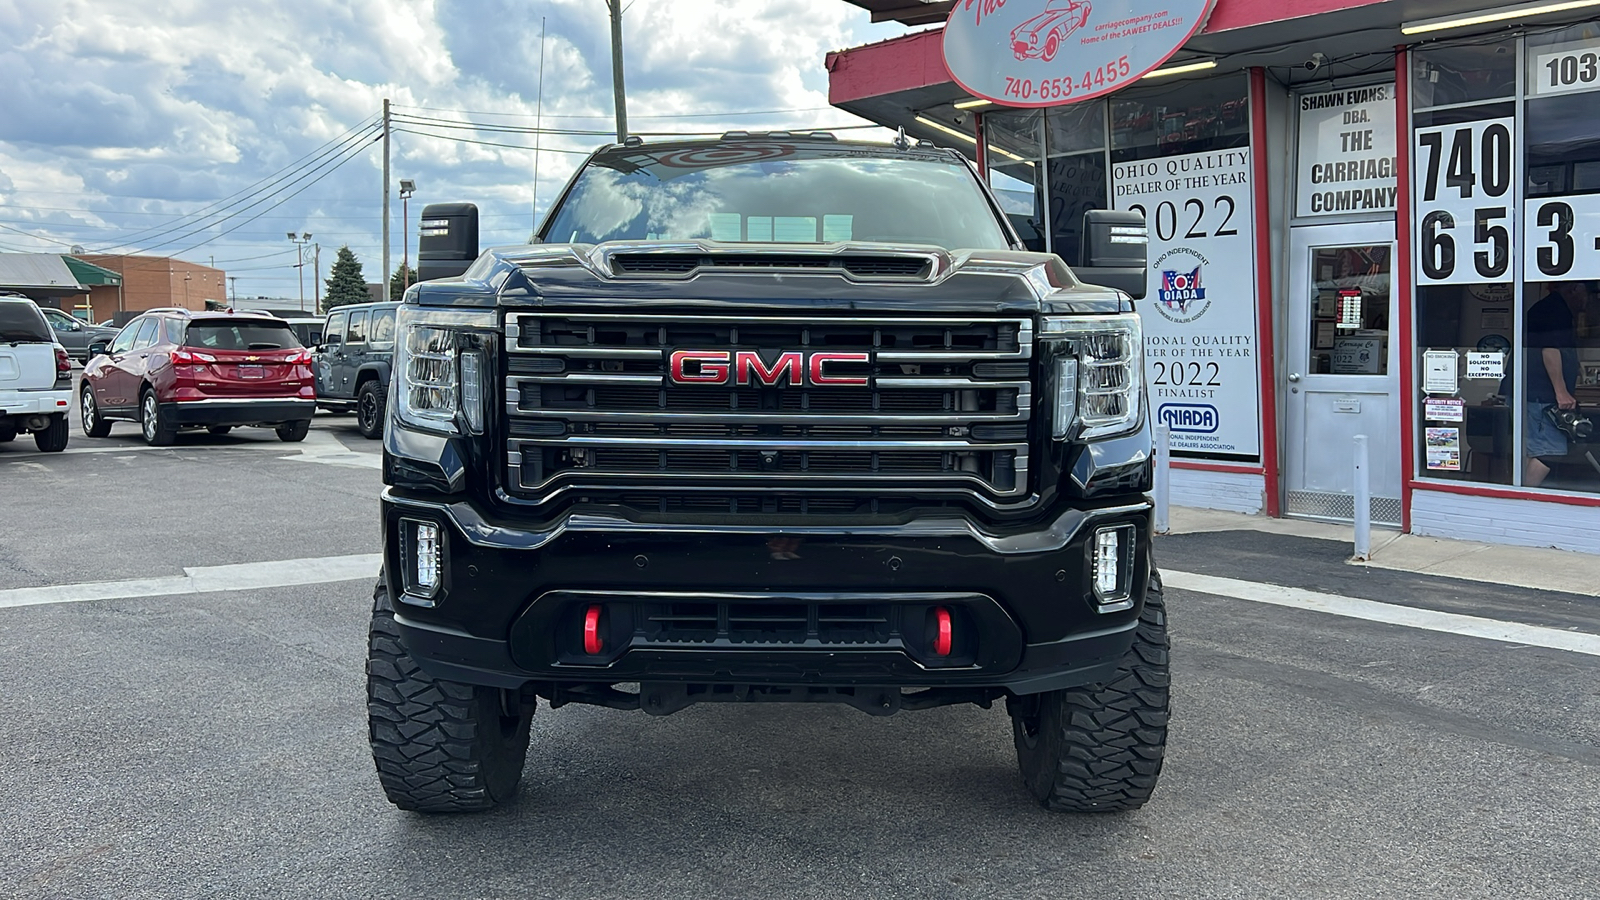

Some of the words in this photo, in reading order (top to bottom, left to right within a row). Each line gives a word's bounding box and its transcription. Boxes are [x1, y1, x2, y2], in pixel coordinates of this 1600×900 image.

[1081, 36, 1099, 45] Home
[1101, 33, 1108, 41] of
[1122, 24, 1151, 37] SAWEET
[1152, 17, 1183, 30] DEALS!!!
[1095, 10, 1168, 31] carriagecompany.com
[1004, 55, 1130, 99] 740-653-4455
[1546, 52, 1600, 87] 103
[1302, 92, 1344, 111] SHAWN
[1347, 86, 1387, 105] EVANS.
[1343, 109, 1370, 125] DBA.
[1340, 129, 1372, 152] THE
[1114, 163, 1158, 180] OHIO
[1166, 151, 1248, 175] QUALITY
[1419, 123, 1511, 201] 740
[1116, 181, 1162, 196] DEALER
[1165, 179, 1181, 191] OF
[1184, 175, 1209, 189] THE
[1212, 171, 1247, 186] YEAR
[1311, 186, 1397, 213] COMPANY
[1153, 253, 1167, 269] OHIO
[1166, 247, 1210, 266] INDEPENDENT
[1164, 289, 1198, 301] OIADA
[1143, 336, 1186, 345] IONAL
[1192, 335, 1251, 347] QUALITY
[1171, 348, 1186, 357] OF
[1190, 348, 1214, 357] THE
[1219, 348, 1251, 357] YEAR
[670, 351, 870, 386] GMC
[1153, 361, 1221, 386] 2022
[1158, 388, 1215, 398] FINALIST
[1162, 409, 1213, 427] NIADA
[1185, 434, 1220, 442] INDEPENDENT
[1199, 442, 1236, 451] ASSOCIATION
